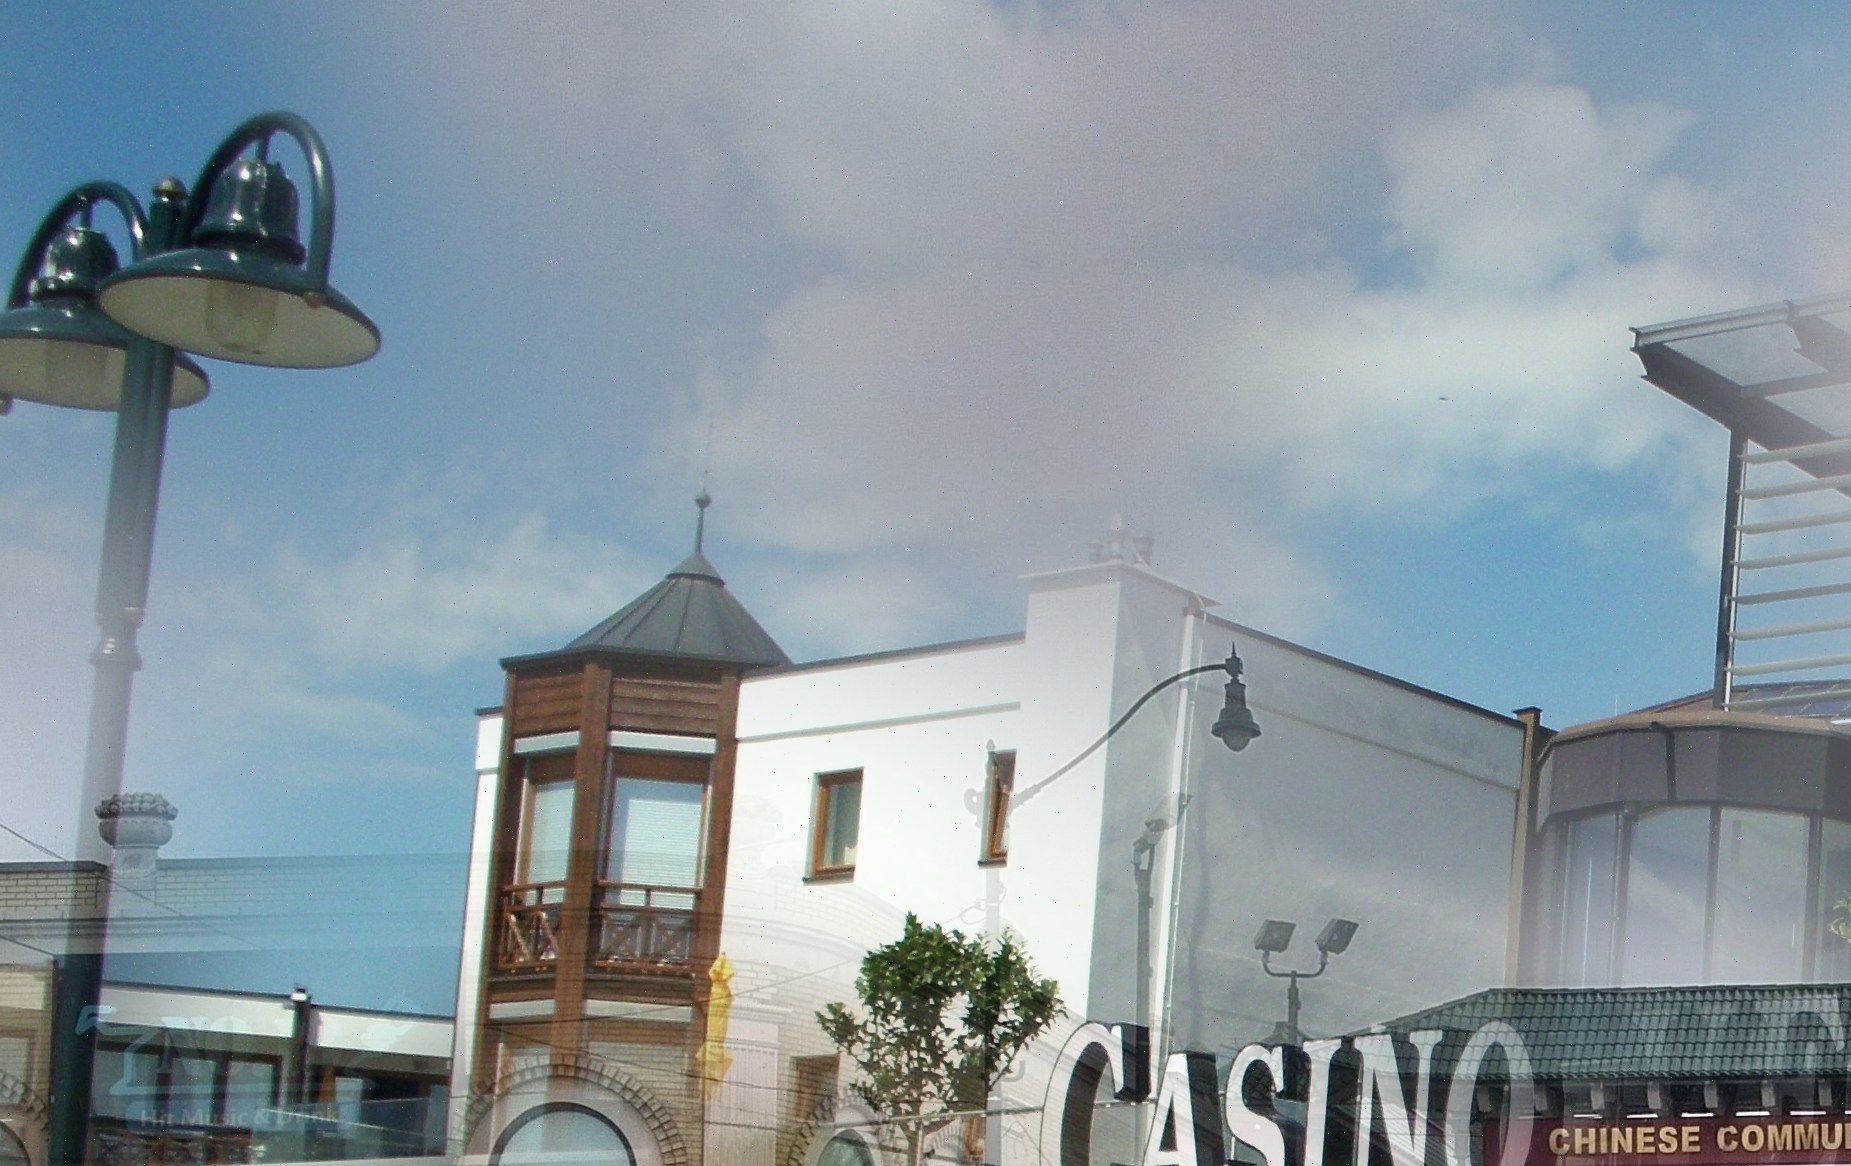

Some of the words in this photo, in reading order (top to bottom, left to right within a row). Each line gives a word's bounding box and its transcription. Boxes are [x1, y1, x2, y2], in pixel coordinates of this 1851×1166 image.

[140, 1109, 175, 1126] Hit
[181, 1110, 249, 1126] Music
[253, 1110, 271, 1126] &
[1549, 1126, 1701, 1155] CHINESE
